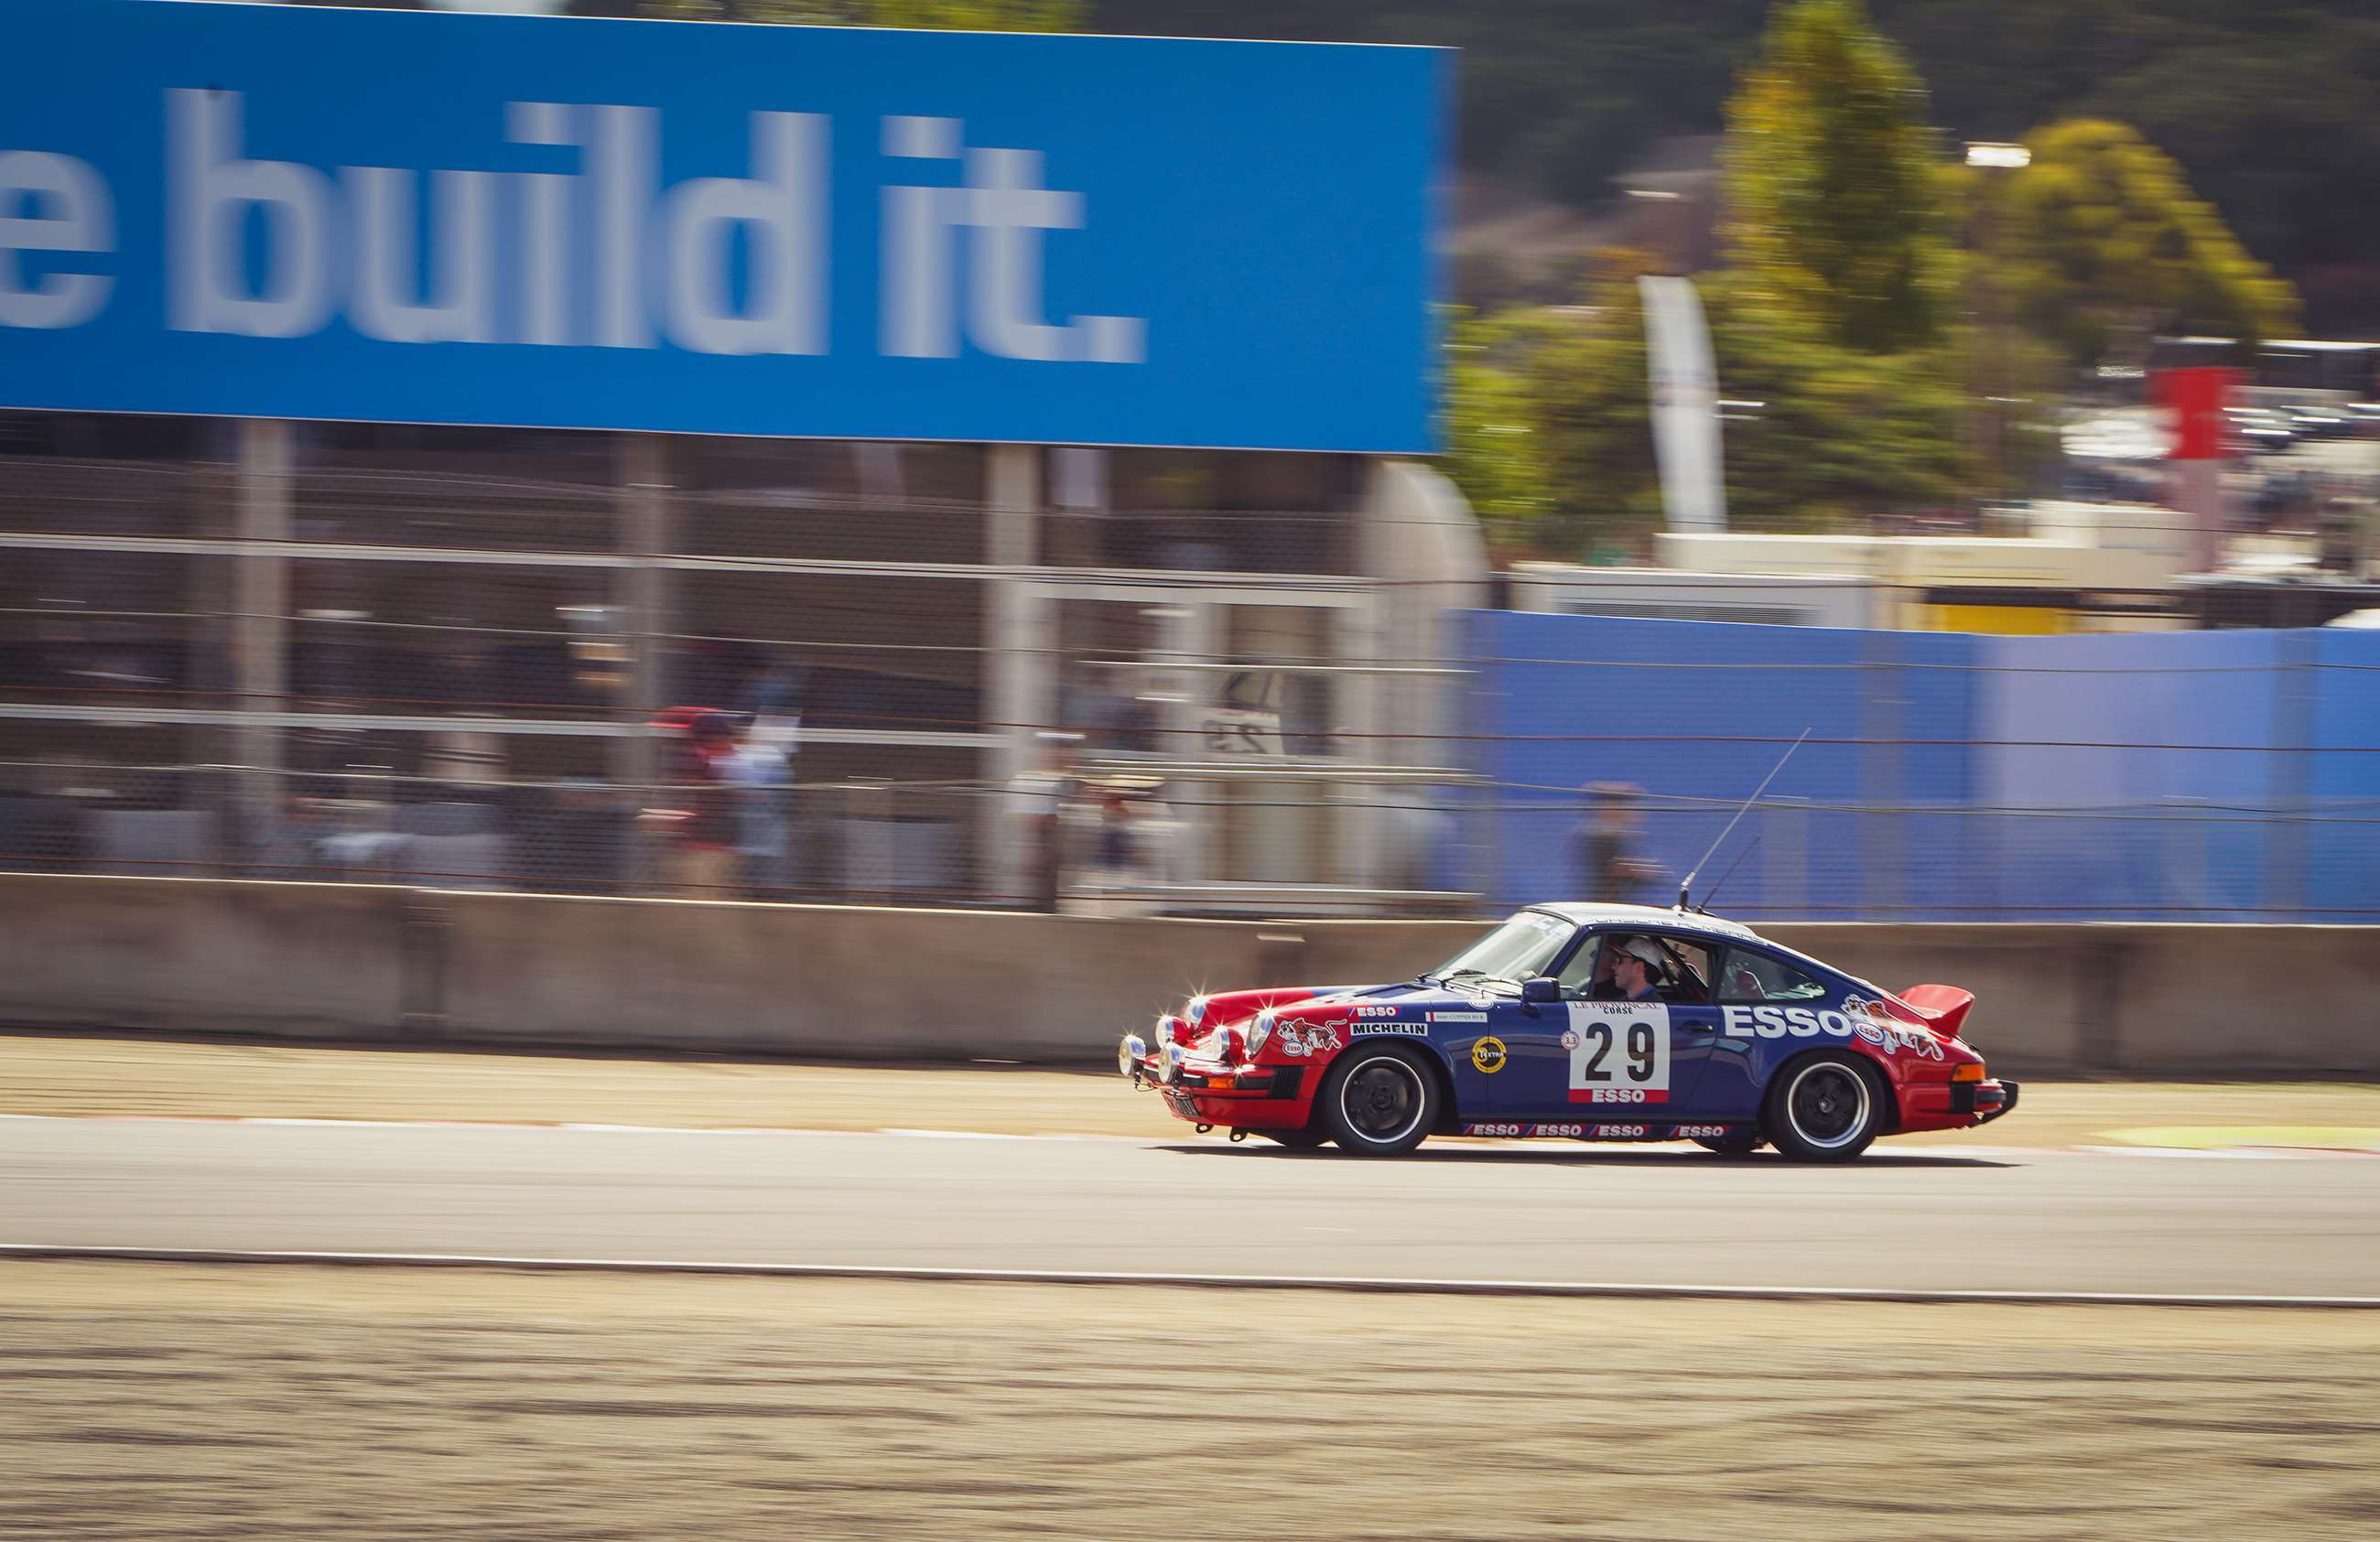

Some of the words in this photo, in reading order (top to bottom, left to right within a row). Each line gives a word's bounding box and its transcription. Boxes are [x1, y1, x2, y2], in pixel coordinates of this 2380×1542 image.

[163, 88, 832, 357] build
[879, 115, 1147, 363] it.
[1357, 1006, 1397, 1017] ESSO
[1721, 1005, 1853, 1039] ESSO
[1353, 1024, 1425, 1034] MICHELIN
[1585, 1022, 1655, 1082] 29
[1592, 1089, 1646, 1103] ESSO
[1473, 1124, 1520, 1136] ESSO
[1535, 1124, 1583, 1136] ESSO
[1598, 1125, 1644, 1137] ESSO
[1678, 1126, 1725, 1138] ESSO
